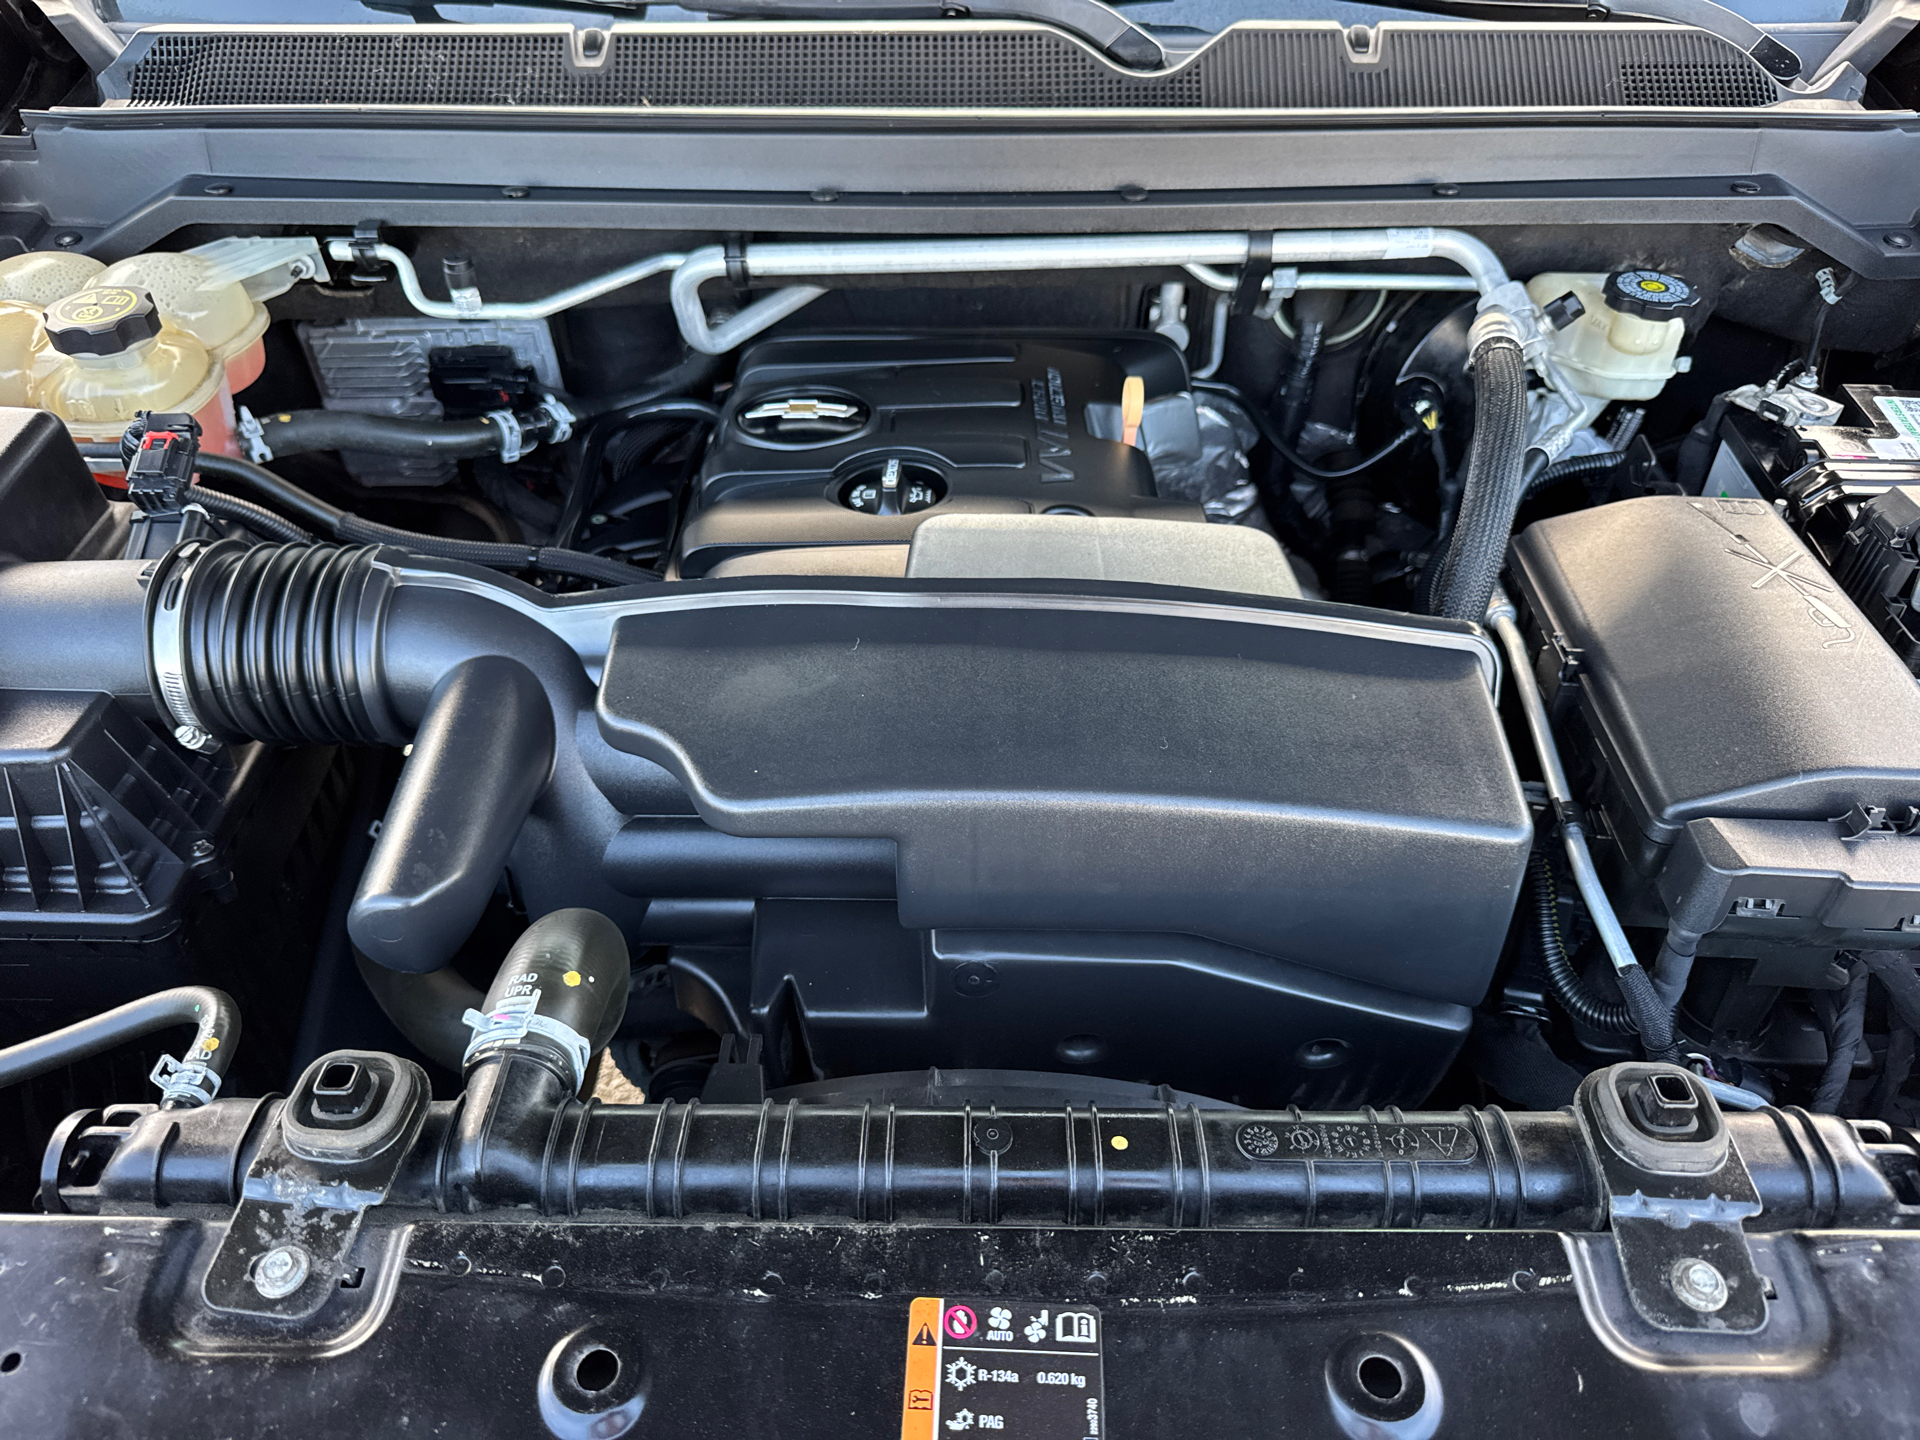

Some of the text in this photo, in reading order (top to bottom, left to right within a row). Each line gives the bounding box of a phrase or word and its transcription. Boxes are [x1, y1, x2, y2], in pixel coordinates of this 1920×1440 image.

[508, 972, 539, 986] RAD
[504, 984, 533, 998] UPR
[986, 1330, 1014, 1342] AUTO
[977, 1369, 1087, 1389] R-134a 0.620 kg
[978, 1414, 1005, 1430] PAG
